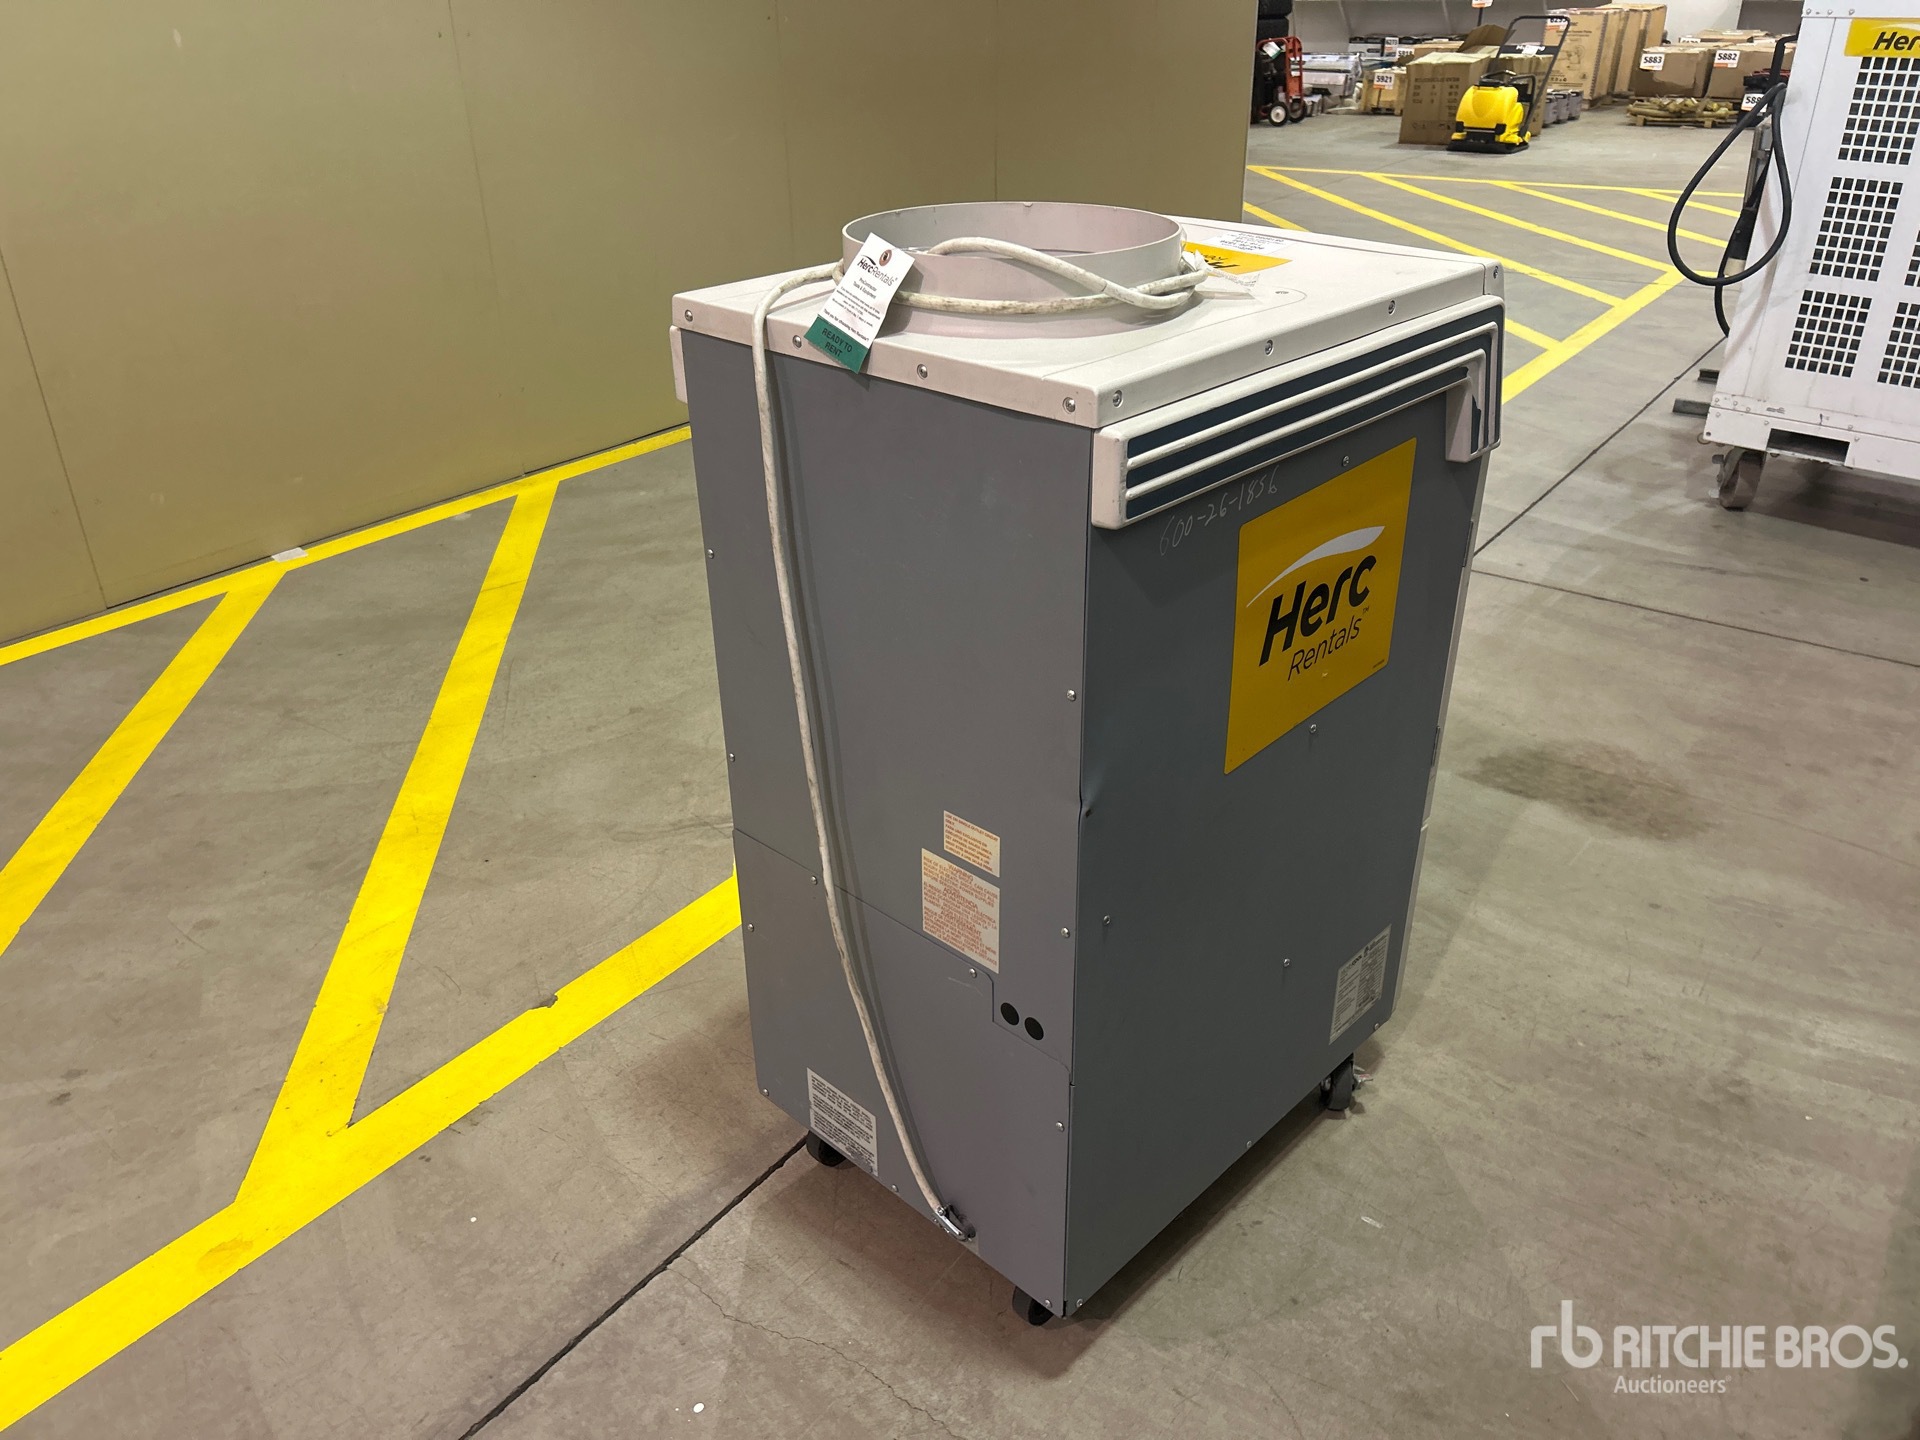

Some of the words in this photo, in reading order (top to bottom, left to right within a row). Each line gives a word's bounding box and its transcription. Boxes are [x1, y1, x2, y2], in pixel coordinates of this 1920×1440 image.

[1873, 31, 1920, 51] Her
[1718, 52, 1738, 60] 5882
[822, 328, 844, 346] READY
[845, 342, 853, 353] TO
[824, 342, 842, 357] RENT
[1258, 555, 1376, 667] Herc
[1287, 615, 1362, 681] Rentals
